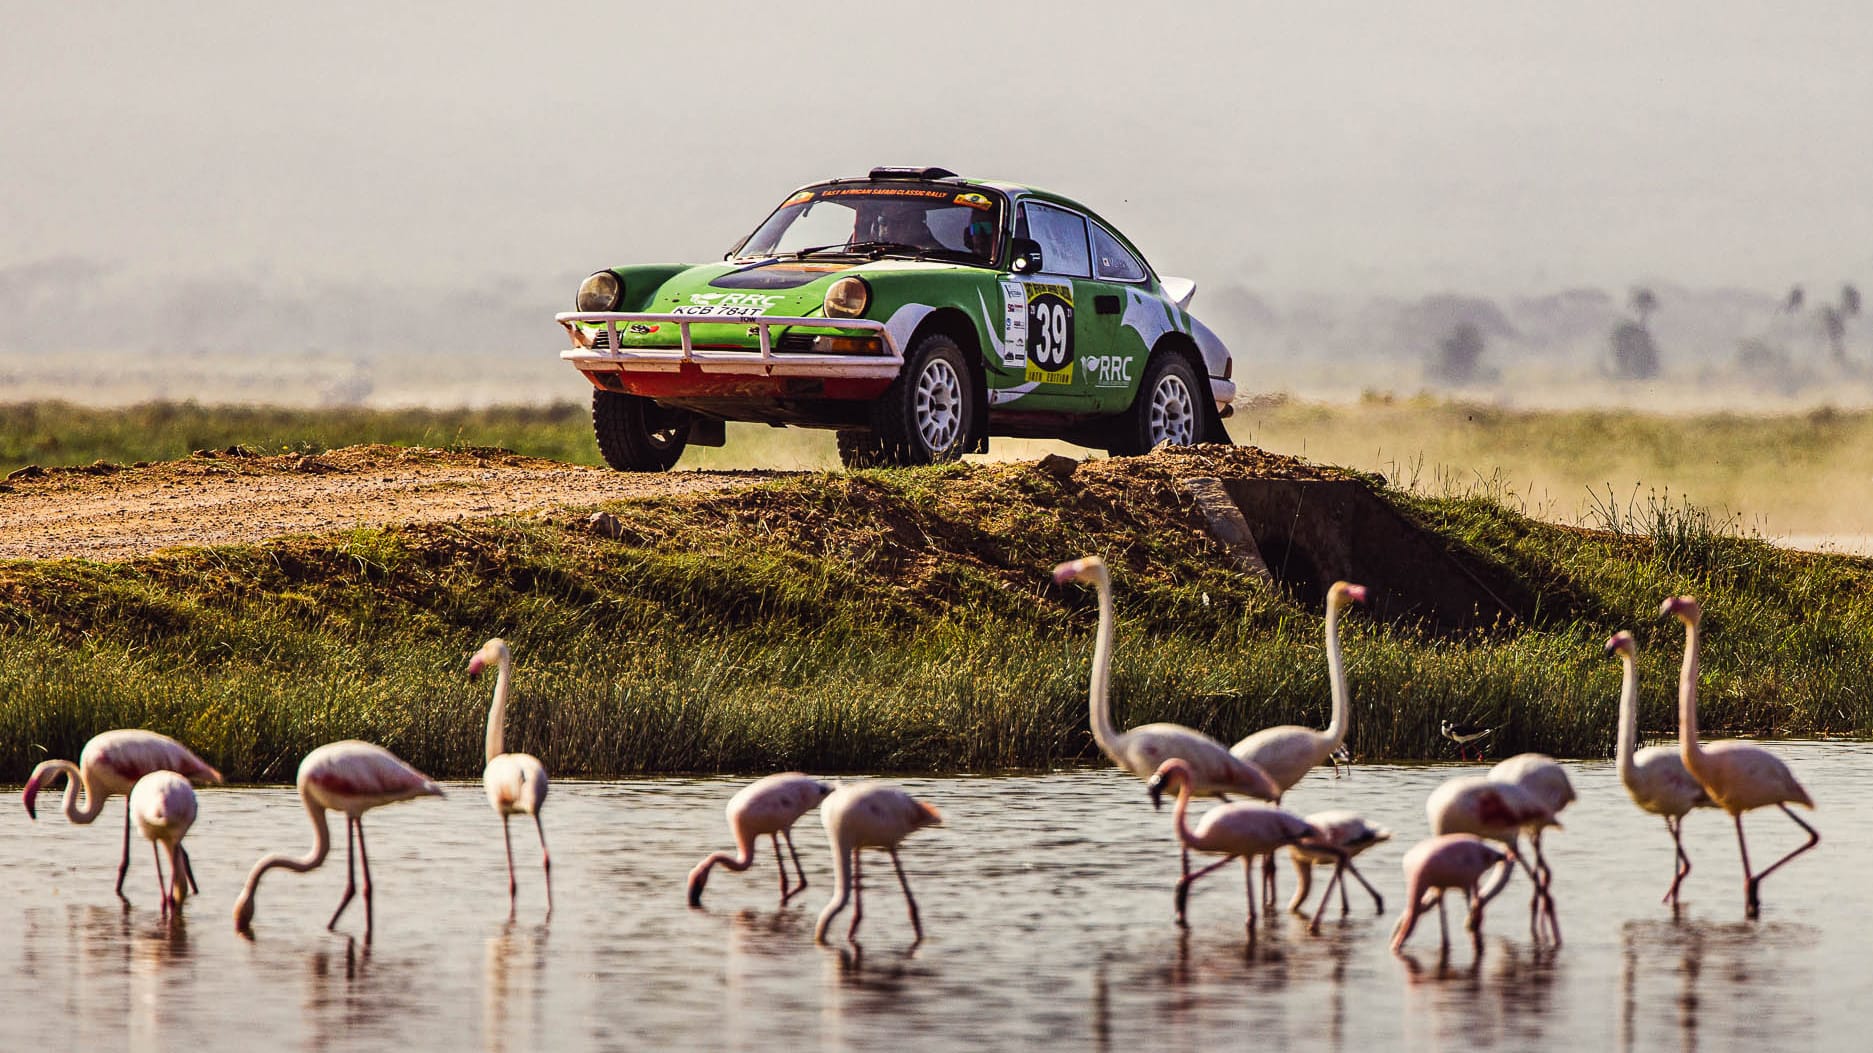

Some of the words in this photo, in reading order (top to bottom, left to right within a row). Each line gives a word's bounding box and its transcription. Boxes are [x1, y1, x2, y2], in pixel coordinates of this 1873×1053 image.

[719, 293, 785, 308] RRC
[673, 306, 714, 315] KCB
[717, 307, 762, 316] 784T
[1036, 303, 1067, 364] 39
[1099, 356, 1133, 381] RRC
[1047, 373, 1069, 383] EDITION
